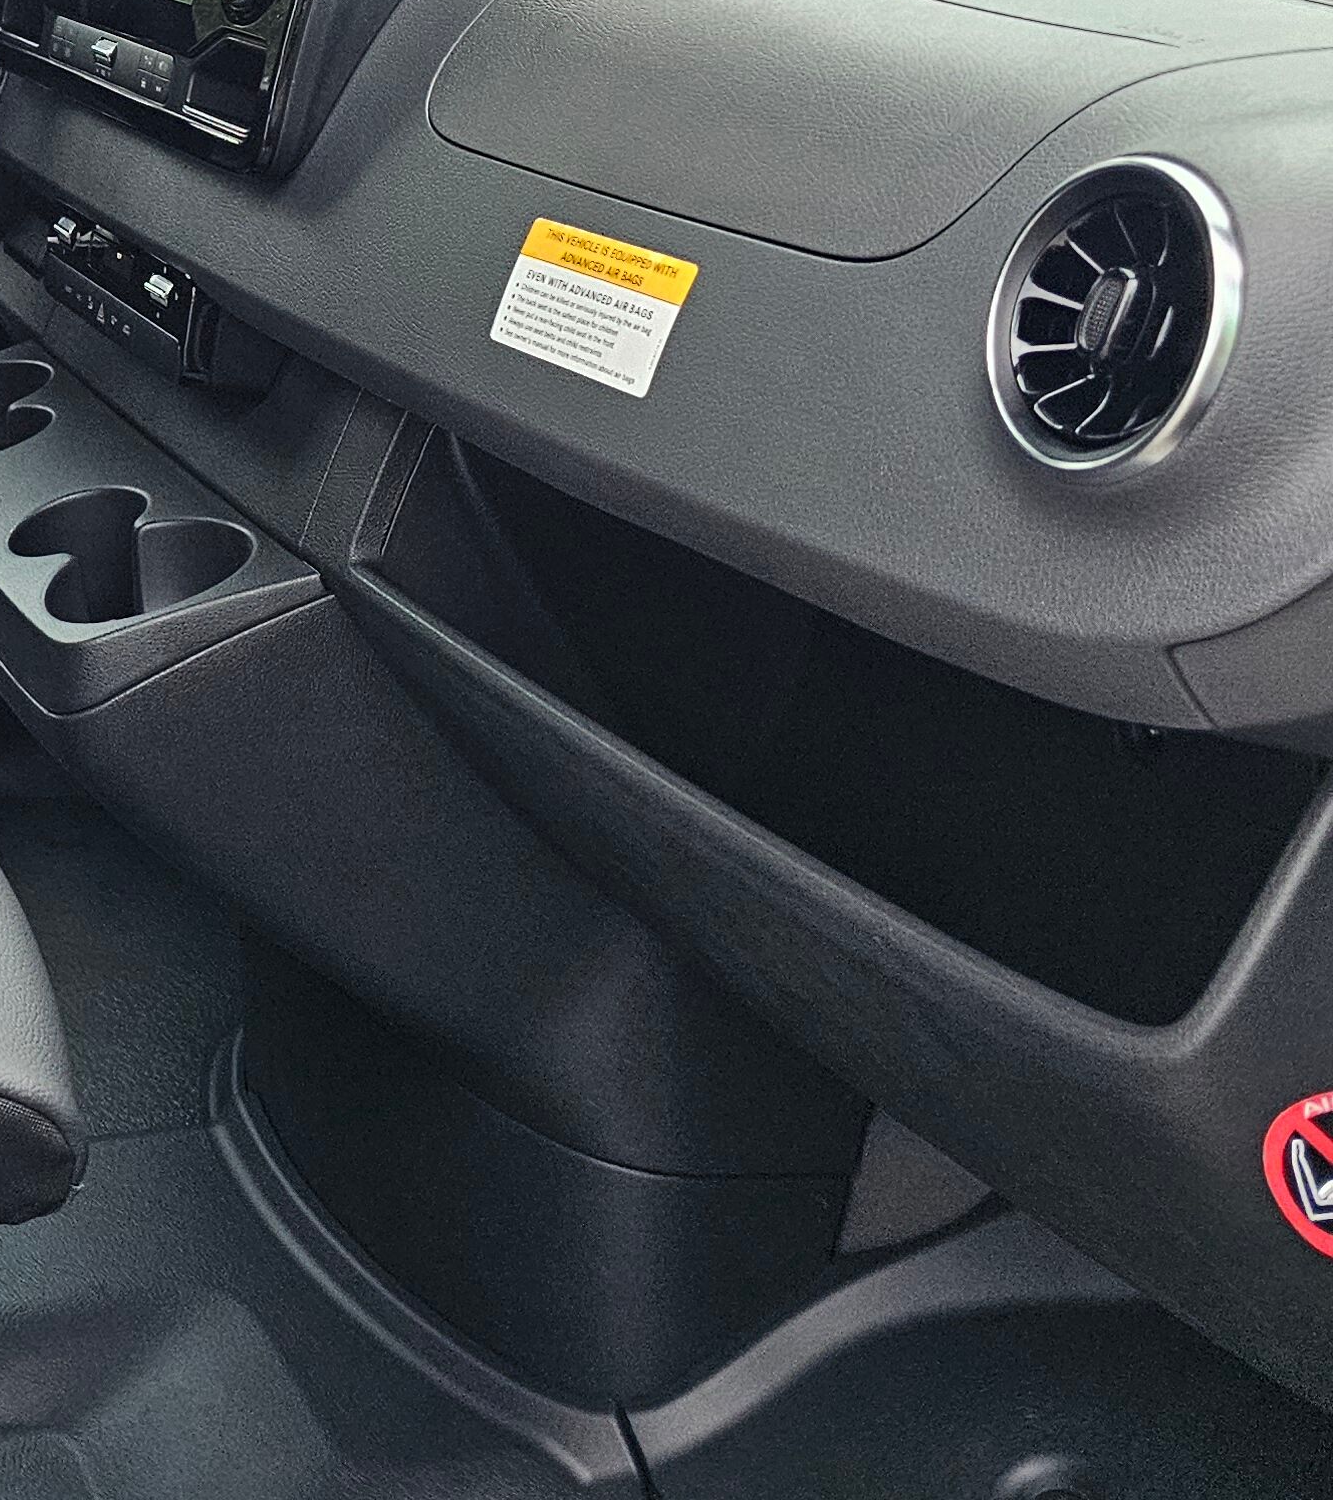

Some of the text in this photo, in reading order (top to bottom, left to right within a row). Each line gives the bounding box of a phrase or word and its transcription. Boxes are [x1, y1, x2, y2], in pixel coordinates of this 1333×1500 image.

[546, 229, 680, 279] THIS VEHICLE IS EQUIPPED WITH
[560, 252, 645, 286] ADVANCED AIR BAGS
[526, 269, 655, 320] EVEN WITH ADVANCED AIR BAGS
[1304, 1094, 1333, 1120] AI
